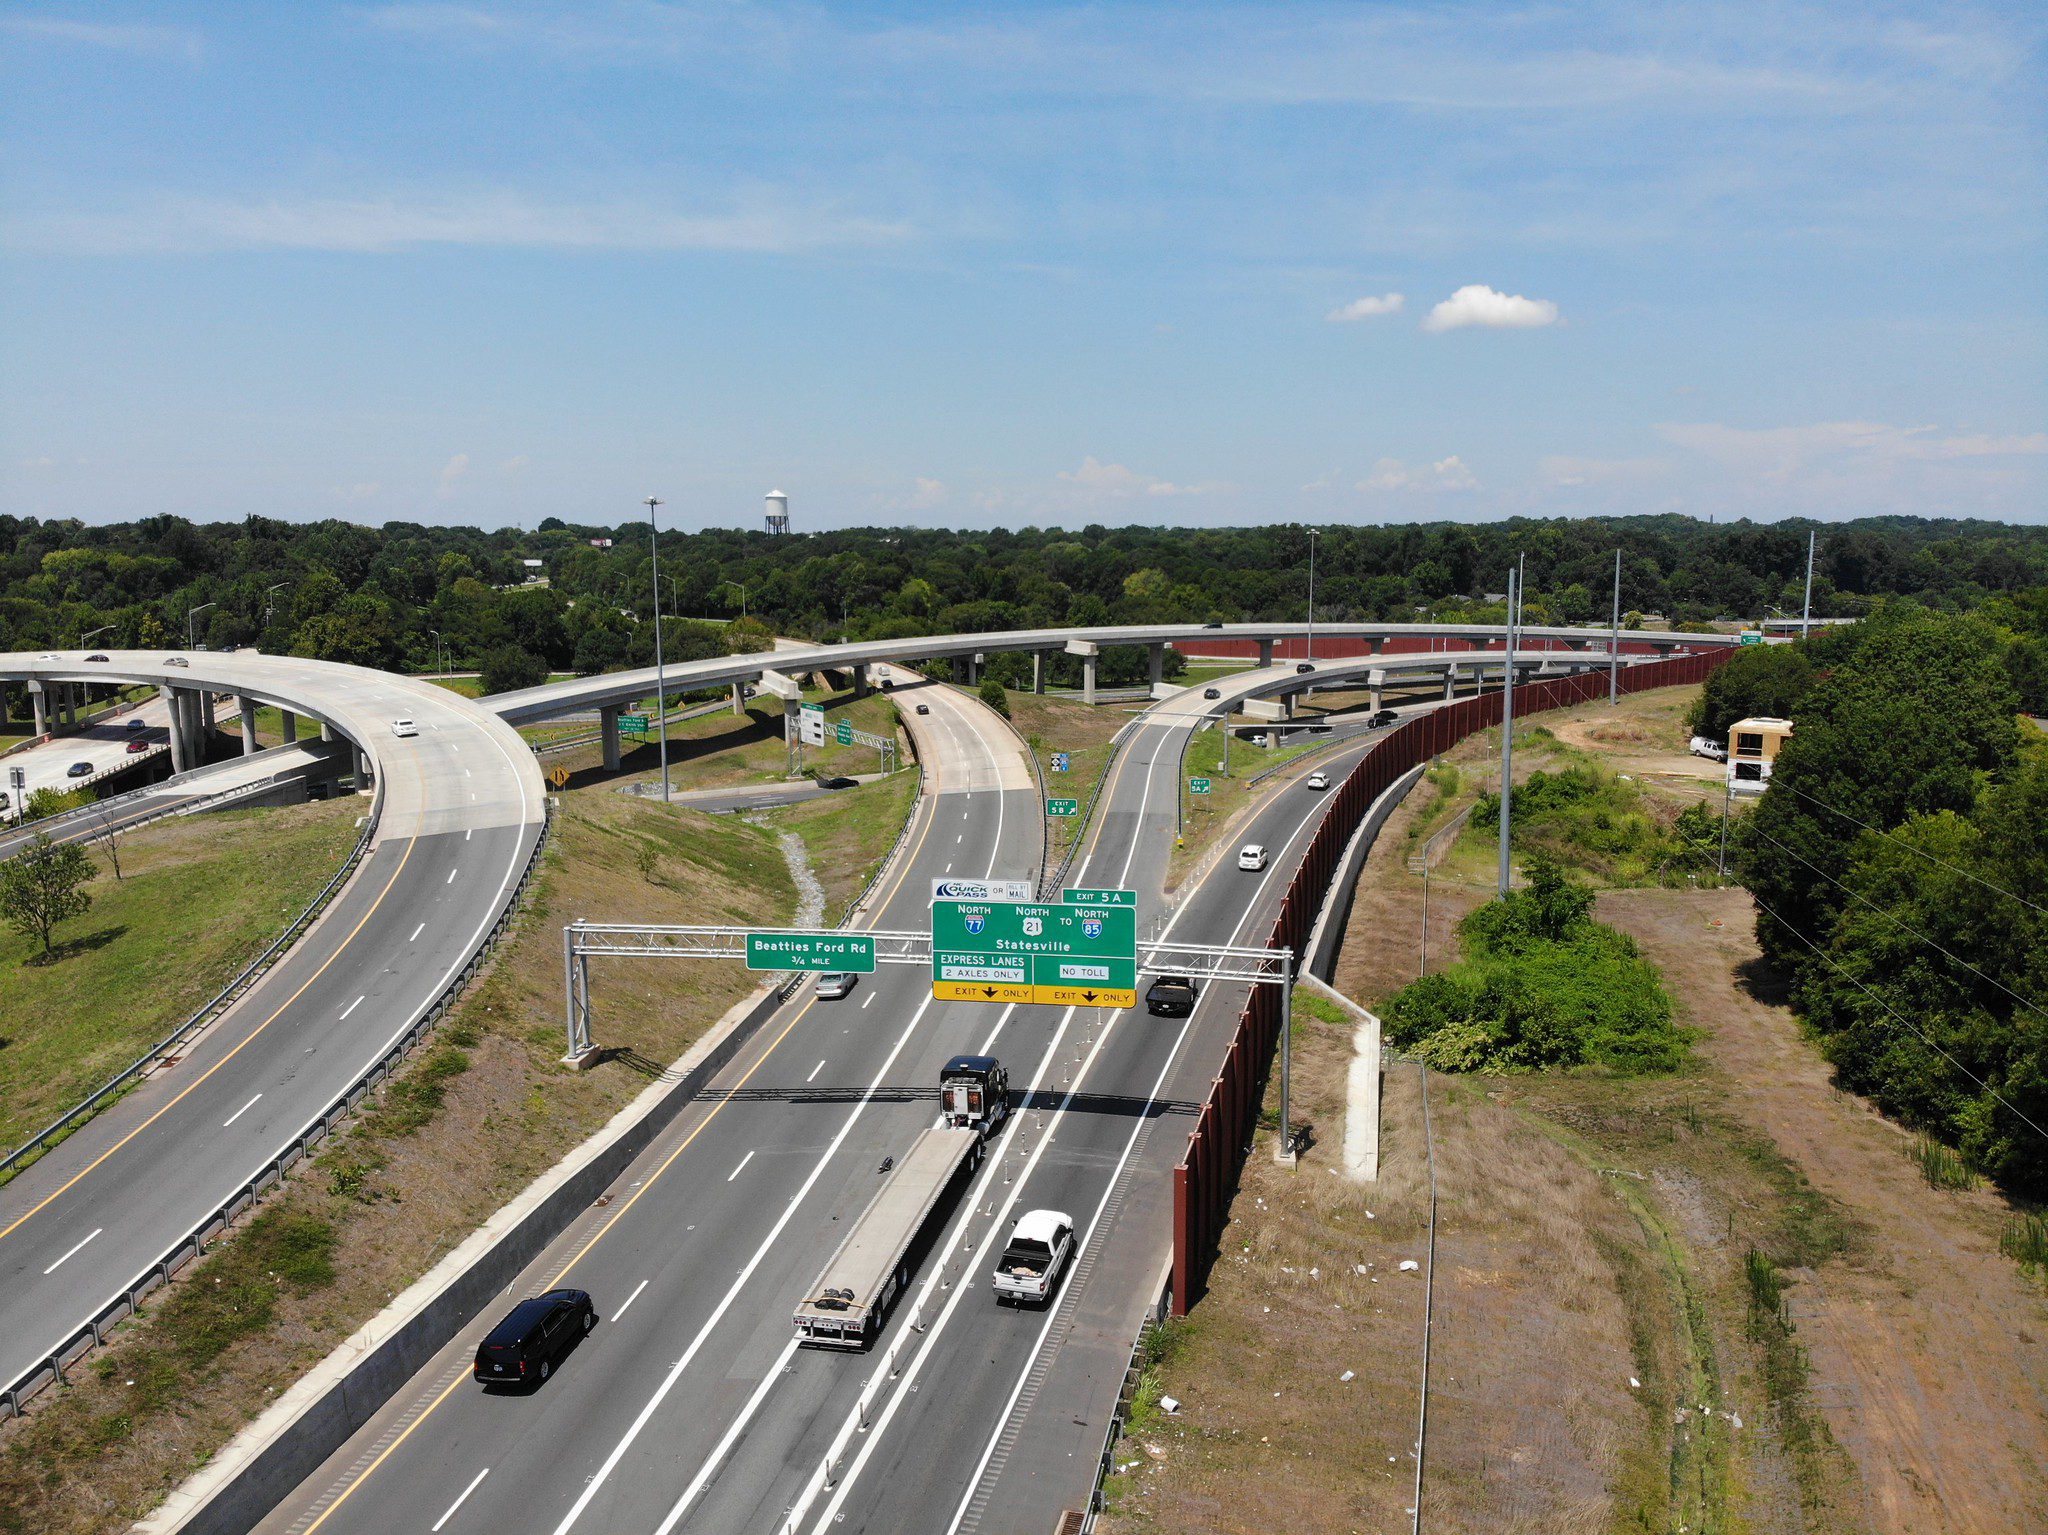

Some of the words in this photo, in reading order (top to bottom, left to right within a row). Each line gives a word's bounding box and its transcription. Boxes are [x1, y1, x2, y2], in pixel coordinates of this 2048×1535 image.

[1009, 890, 1026, 899] MAIL
[957, 904, 991, 915] NORTH
[1015, 906, 1050, 917] NORTH
[1074, 908, 1109, 919] NORTH
[967, 920, 982, 931] 77
[1026, 922, 1039, 932] 21
[1060, 917, 1072, 926] TO
[1084, 924, 1100, 935] 85
[754, 940, 810, 952] Beatties
[816, 942, 845, 953] Ford
[850, 943, 867, 954] Rd
[996, 939, 1071, 952] Statesville
[940, 954, 985, 965] EXPRESS
[991, 956, 1025, 967] LANES
[957, 970, 988, 978] AXLES
[993, 970, 1019, 978] ONLY
[1062, 968, 1076, 976] NO
[1081, 968, 1106, 977] TOLL
[955, 987, 977, 995] EXIT
[1003, 989, 1029, 997] ONLY
[1054, 991, 1077, 1000] EXIT
[1103, 994, 1130, 1002] ONLY
